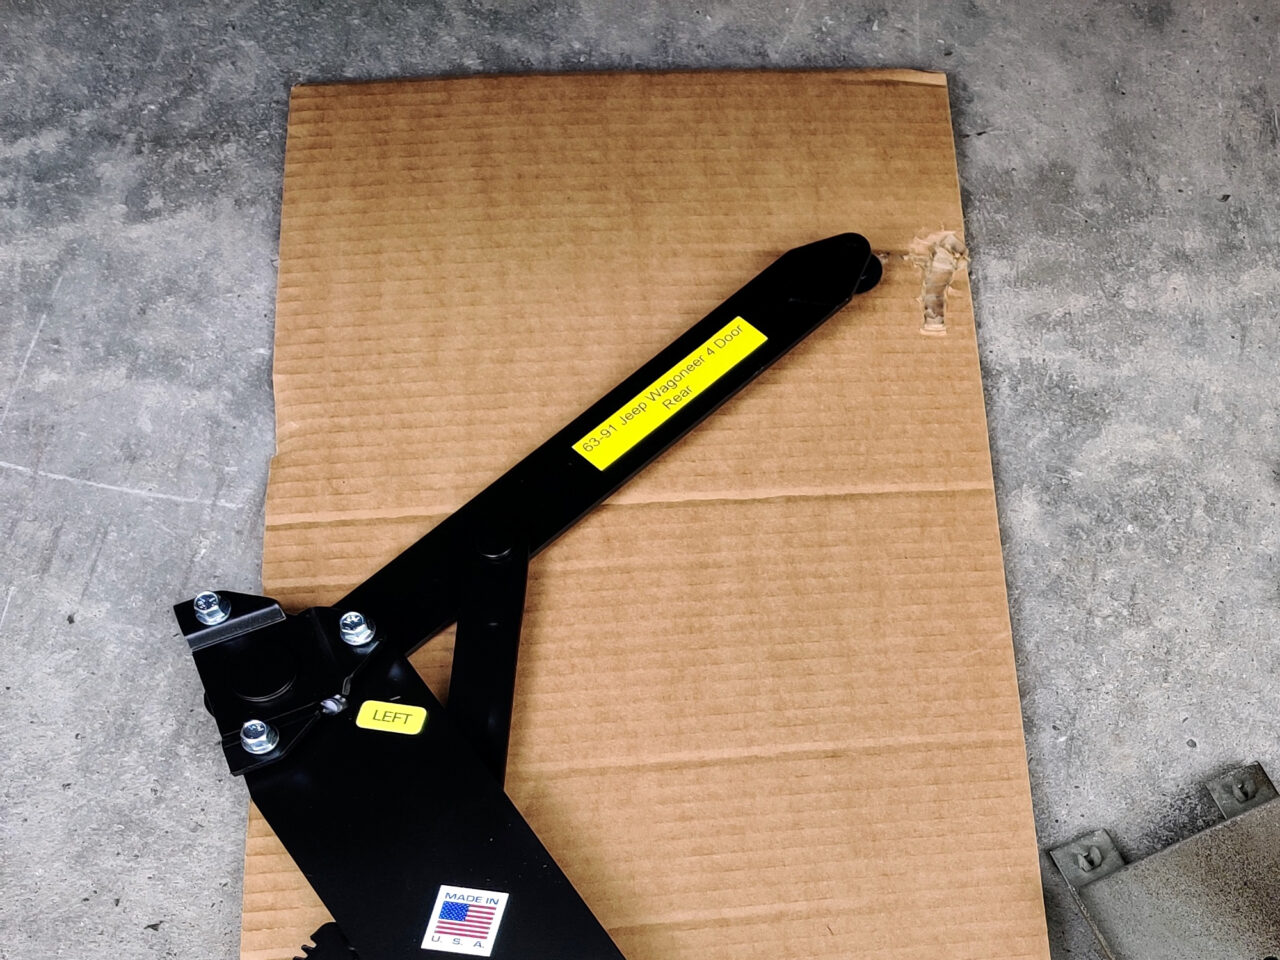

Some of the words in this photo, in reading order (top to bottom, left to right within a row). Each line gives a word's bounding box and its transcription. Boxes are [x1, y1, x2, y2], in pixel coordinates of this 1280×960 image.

[582, 424, 617, 453] 63-91
[619, 401, 648, 426] Jeep
[645, 354, 706, 403] Wagoneer
[705, 346, 716, 358] 4
[713, 323, 743, 349] Door
[662, 385, 693, 411] Rear
[372, 709, 413, 725] LEFT
[444, 892, 483, 904] MADE
[485, 897, 500, 905] IN
